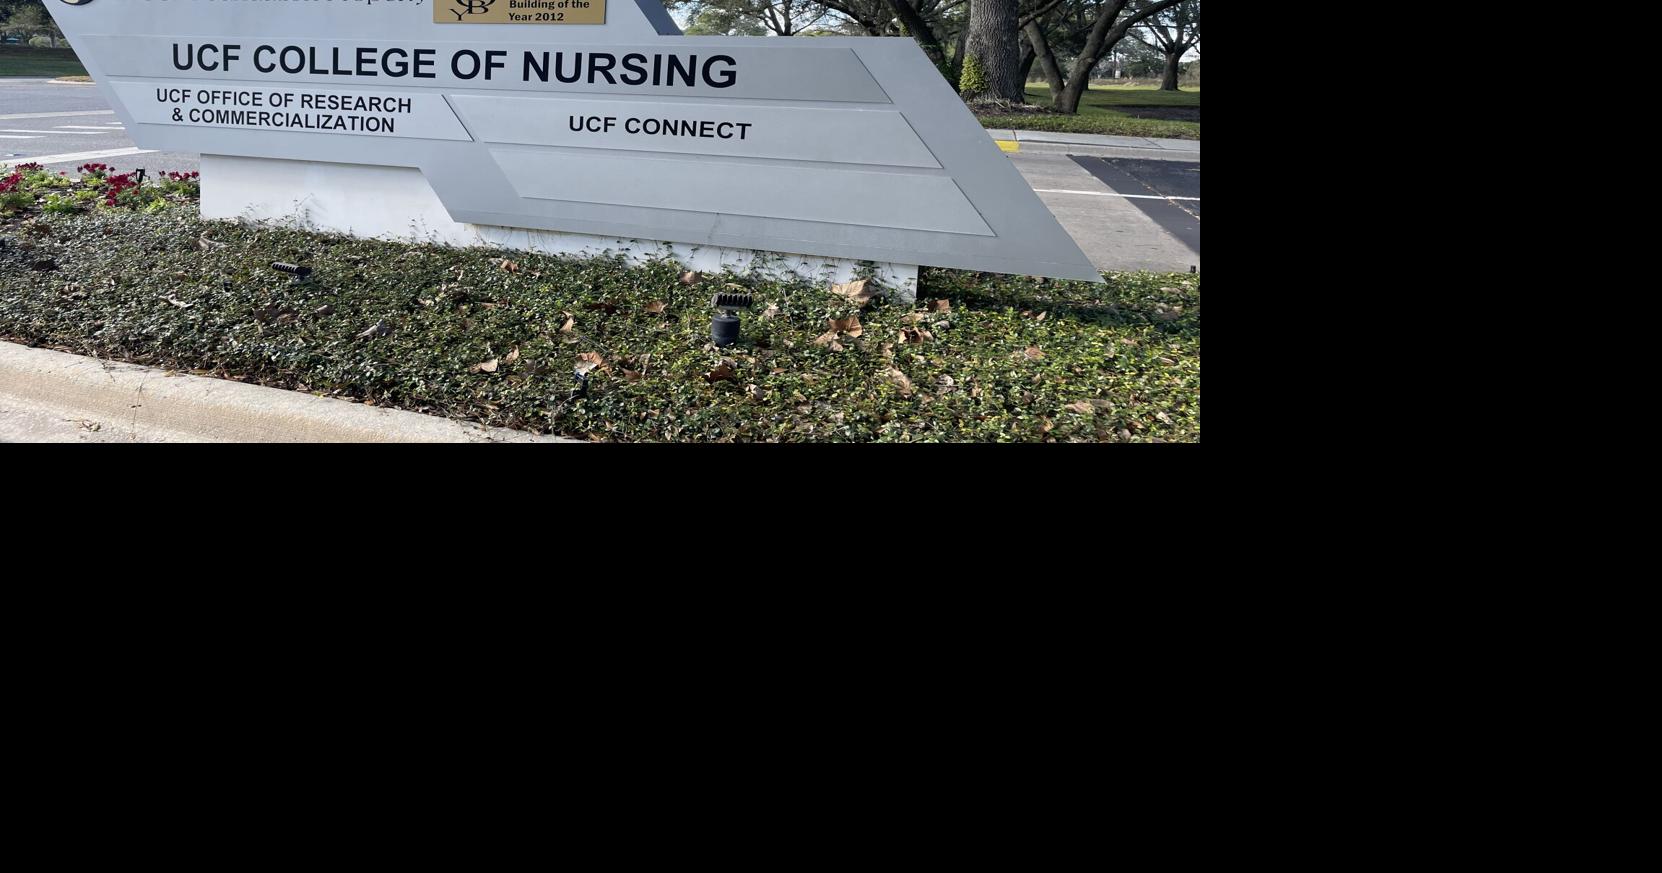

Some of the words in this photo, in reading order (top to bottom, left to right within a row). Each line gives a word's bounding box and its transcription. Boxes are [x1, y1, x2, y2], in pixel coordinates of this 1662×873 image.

[508, 12, 533, 22] Year
[534, 12, 564, 22] 2012
[509, 0, 555, 10] Building
[557, 0, 570, 9] of
[571, 0, 590, 9] the
[172, 43, 241, 72] UCF
[253, 44, 436, 79] COLLEGE
[450, 49, 508, 81] OF
[522, 51, 737, 89] NURSING
[156, 88, 192, 104] UCF
[197, 89, 263, 107] OFFICE
[268, 92, 295, 108] OF
[301, 93, 412, 114] RESEARCH
[171, 107, 184, 122] &
[188, 108, 395, 133] COMMERCIALIZATION
[569, 115, 617, 133] UCF
[624, 117, 753, 140] CONNECT
